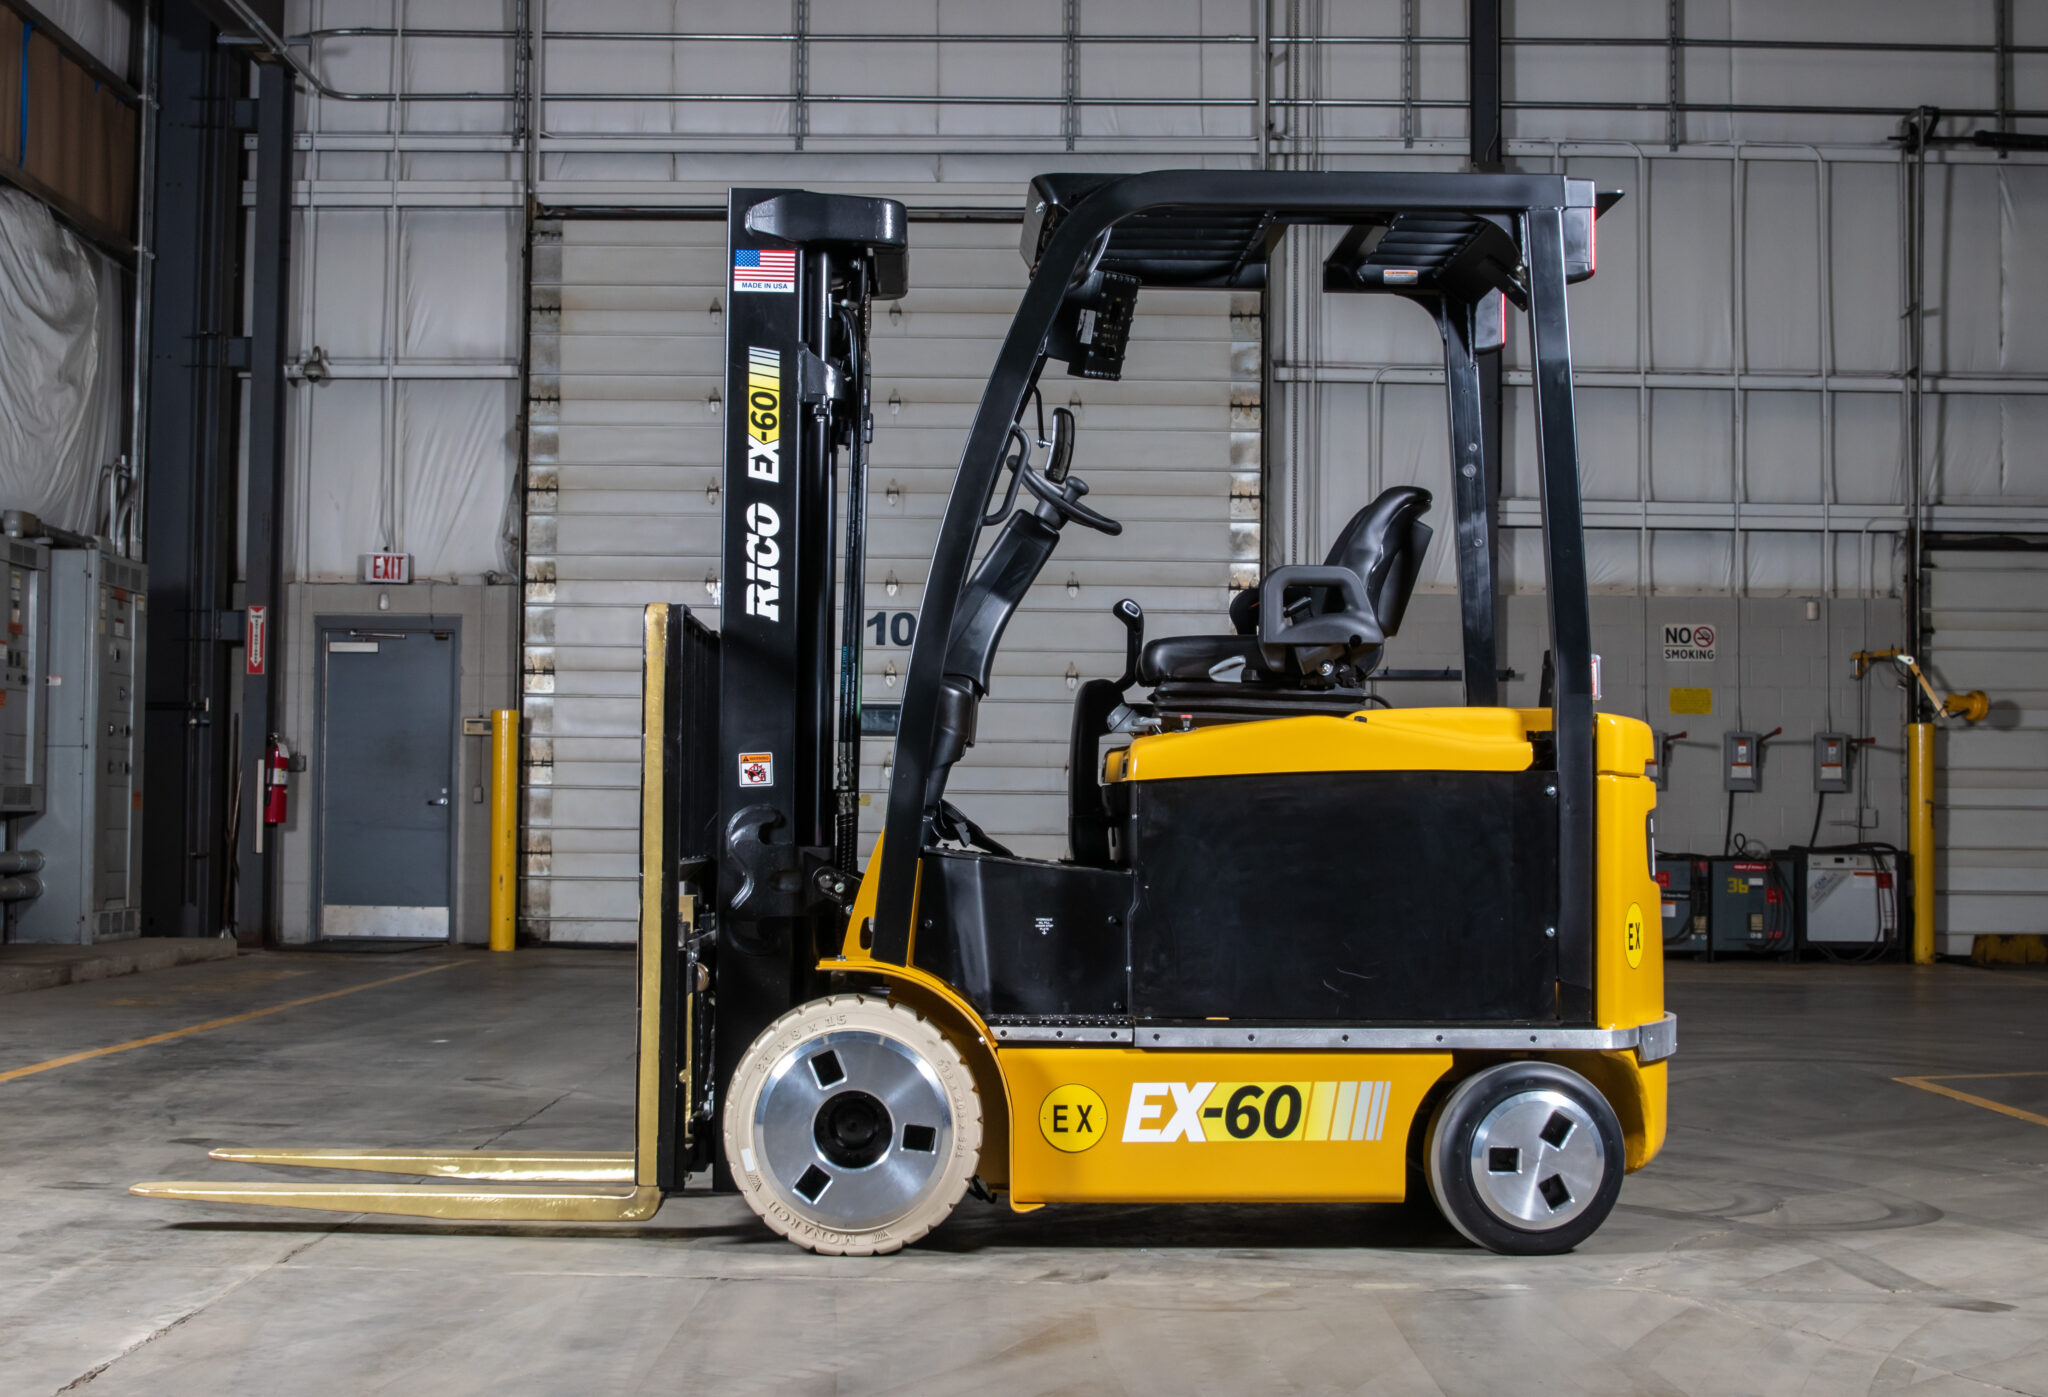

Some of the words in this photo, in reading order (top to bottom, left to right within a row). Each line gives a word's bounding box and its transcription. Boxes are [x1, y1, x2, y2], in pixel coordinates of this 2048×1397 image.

[748, 391, 780, 483] EX-60
[373, 555, 404, 580] EXIT
[746, 502, 781, 622] RICO
[867, 611, 918, 647] 10
[1665, 627, 1692, 644] NO
[1664, 649, 1715, 660] SMOKING
[1628, 922, 1641, 950] EX
[1052, 1104, 1093, 1134] EX
[1122, 1081, 1302, 1143] EX-60
[767, 1200, 858, 1247] MONARCH
